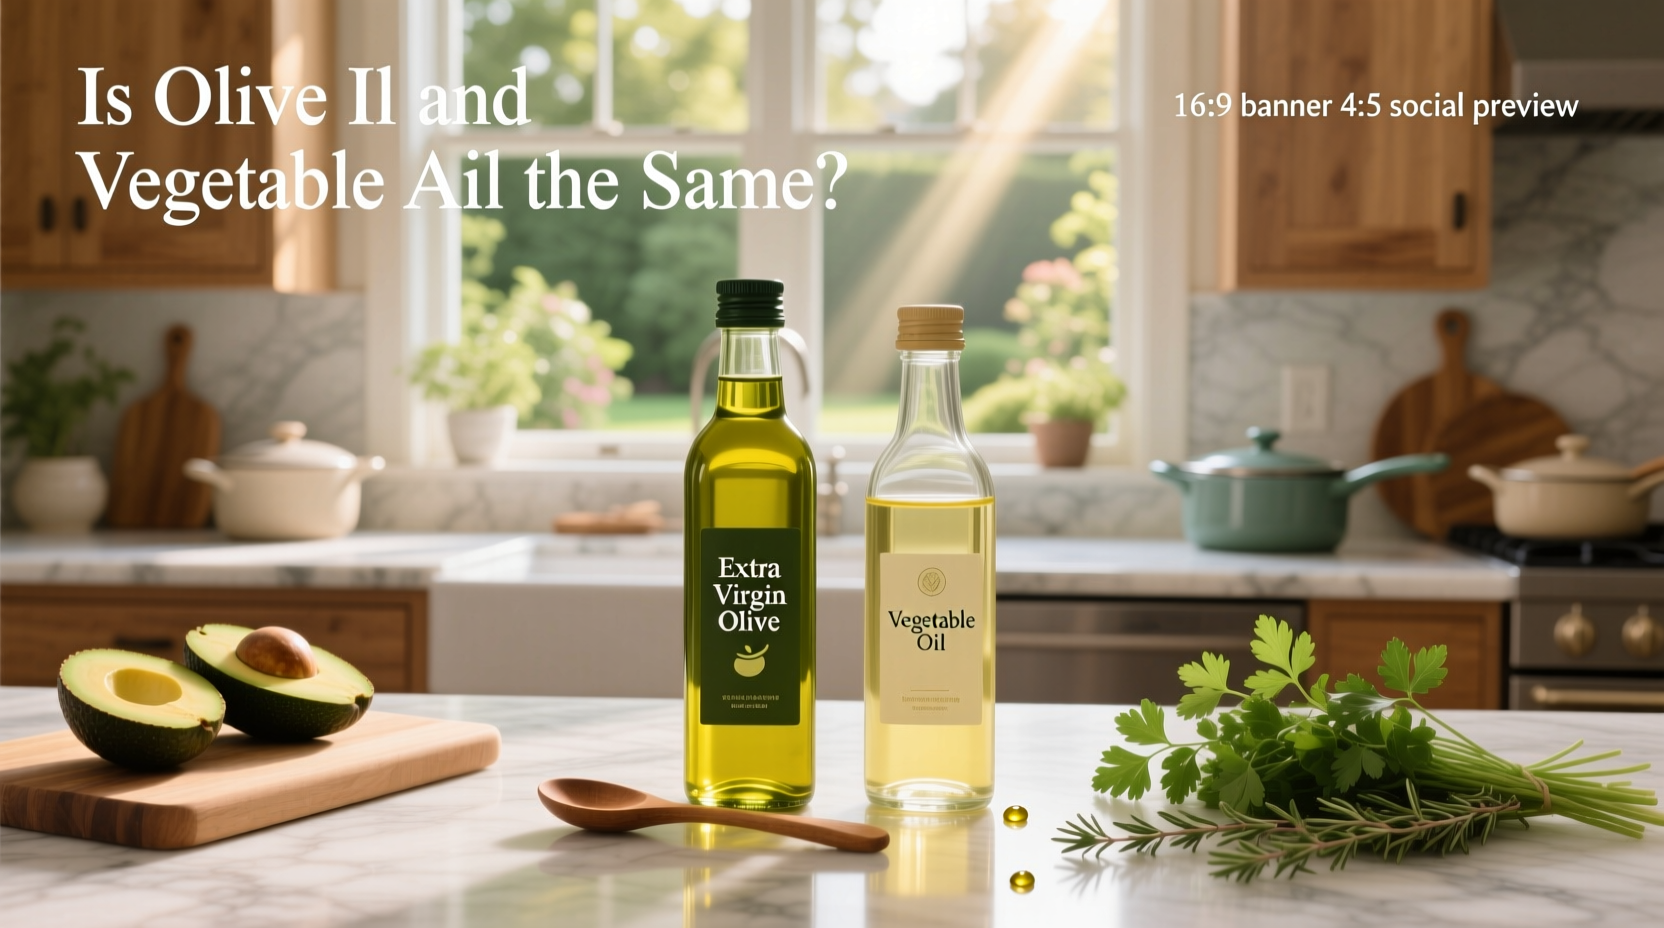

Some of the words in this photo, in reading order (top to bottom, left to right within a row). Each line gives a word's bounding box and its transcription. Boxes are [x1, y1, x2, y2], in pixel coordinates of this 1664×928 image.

[718, 557, 782, 578] Extra
[713, 584, 787, 612] Virgin
[718, 610, 780, 632] Olive
[888, 609, 976, 634] Vegetable
[917, 633, 946, 651] Oil
